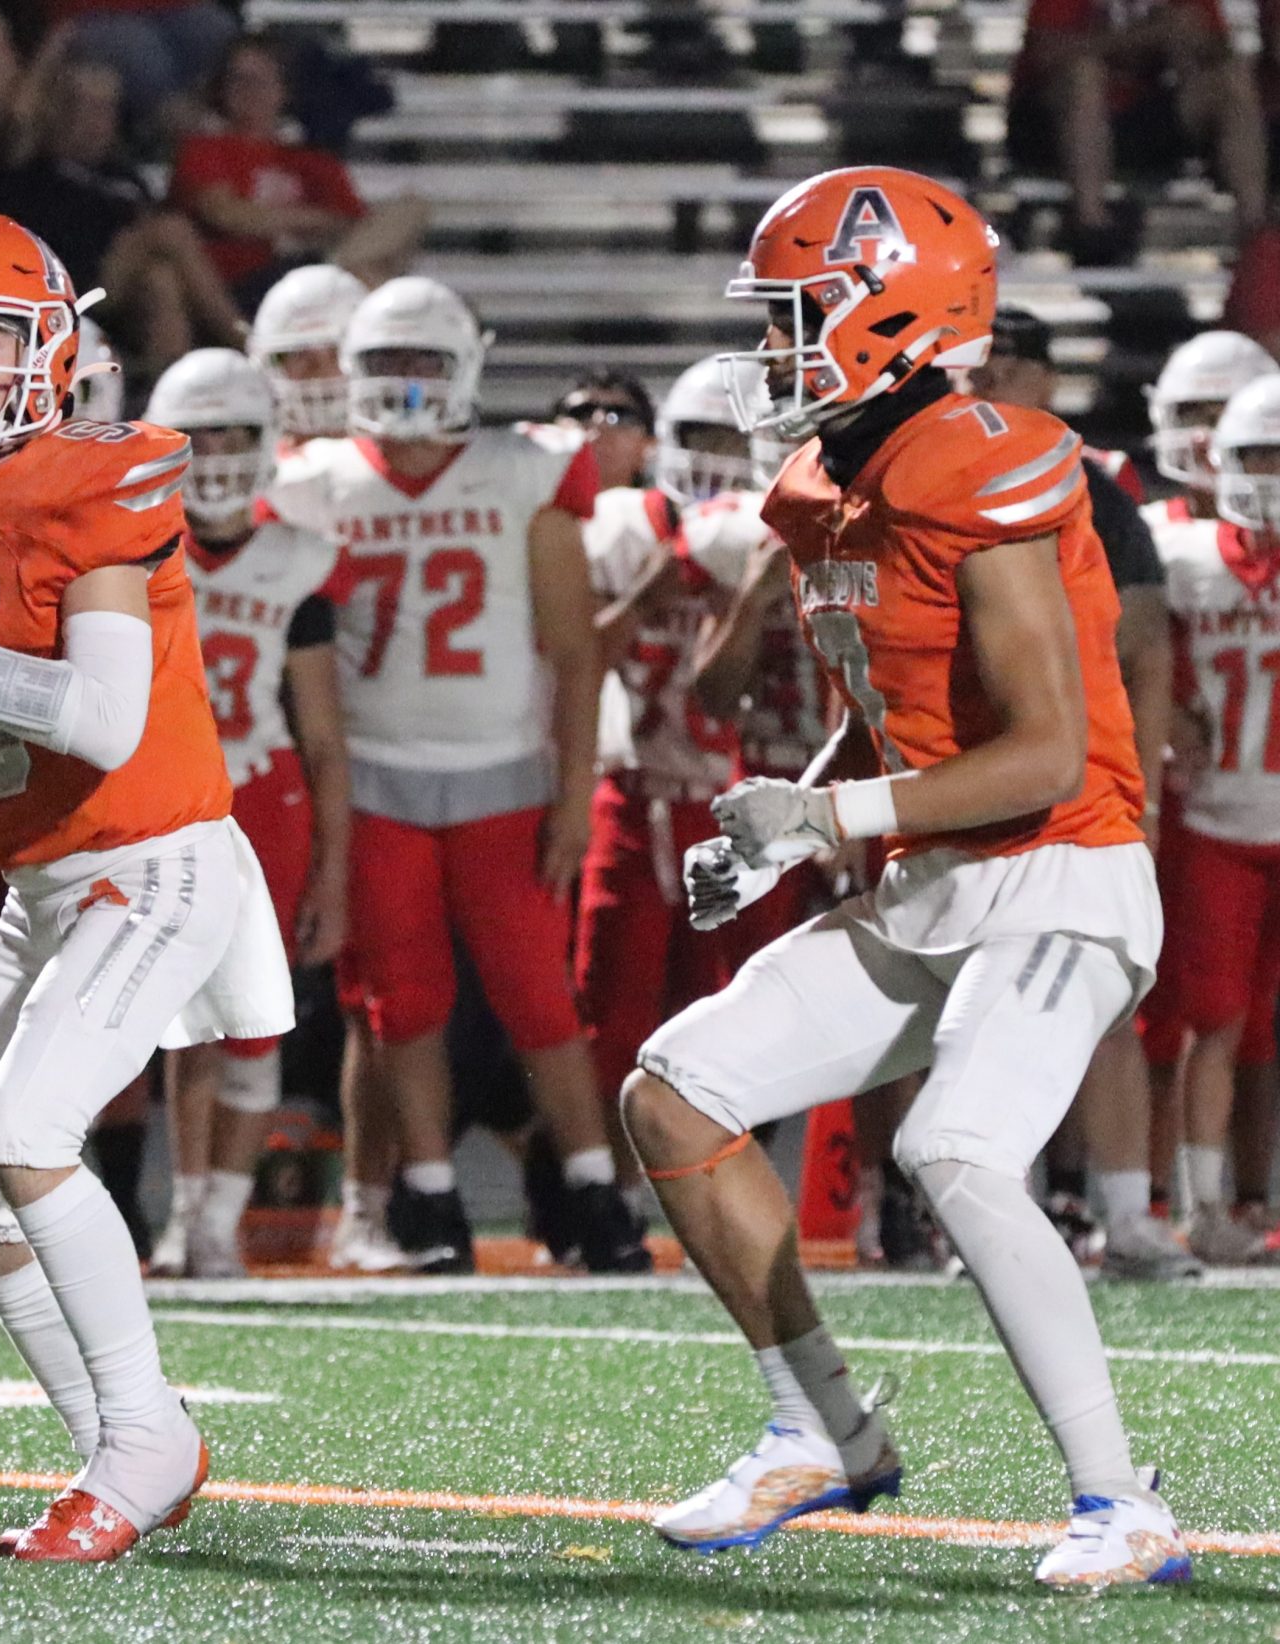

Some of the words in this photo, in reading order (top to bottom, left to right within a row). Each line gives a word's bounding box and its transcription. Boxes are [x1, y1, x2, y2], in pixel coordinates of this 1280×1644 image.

[823, 186, 917, 265] A
[940, 401, 1009, 438] 7
[346, 548, 487, 679] 72
